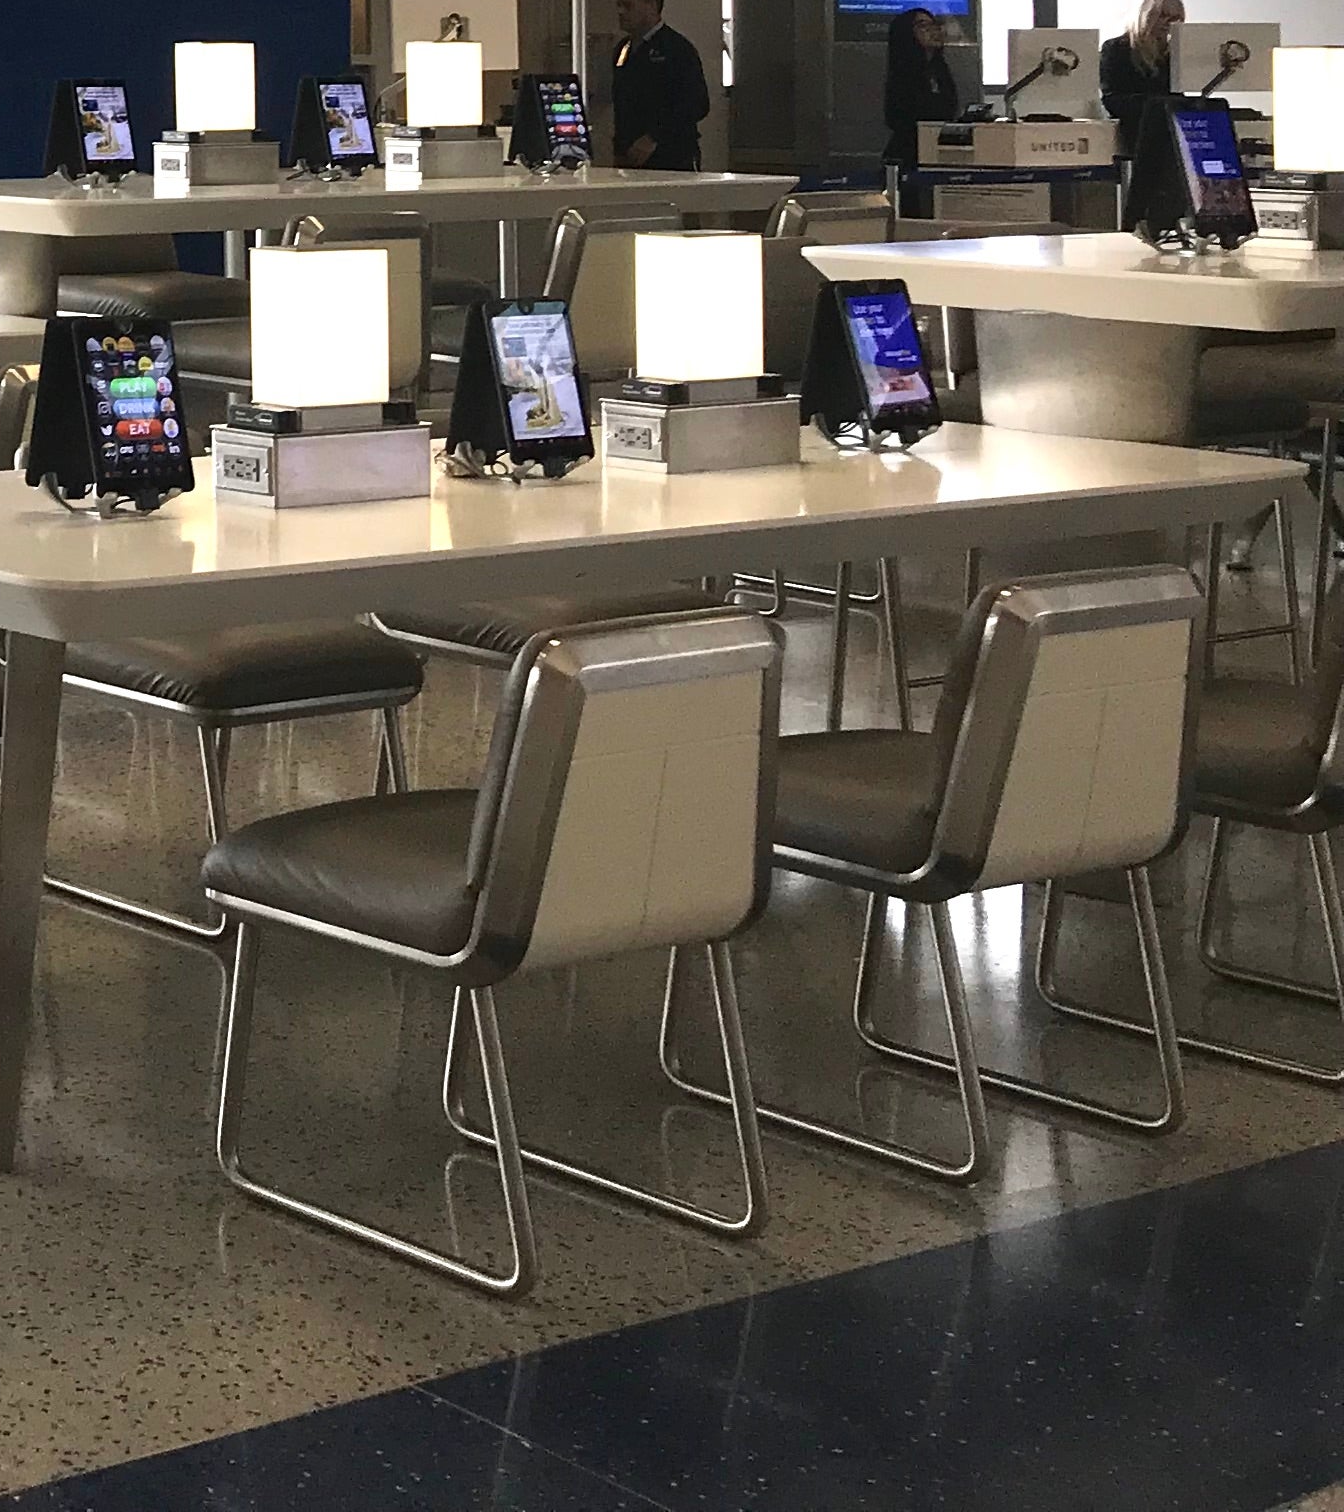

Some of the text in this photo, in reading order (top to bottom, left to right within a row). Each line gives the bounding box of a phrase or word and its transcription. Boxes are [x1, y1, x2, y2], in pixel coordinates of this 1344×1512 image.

[119, 382, 148, 393] PLAY
[119, 404, 155, 415] DRINK
[129, 423, 151, 435] EAT
